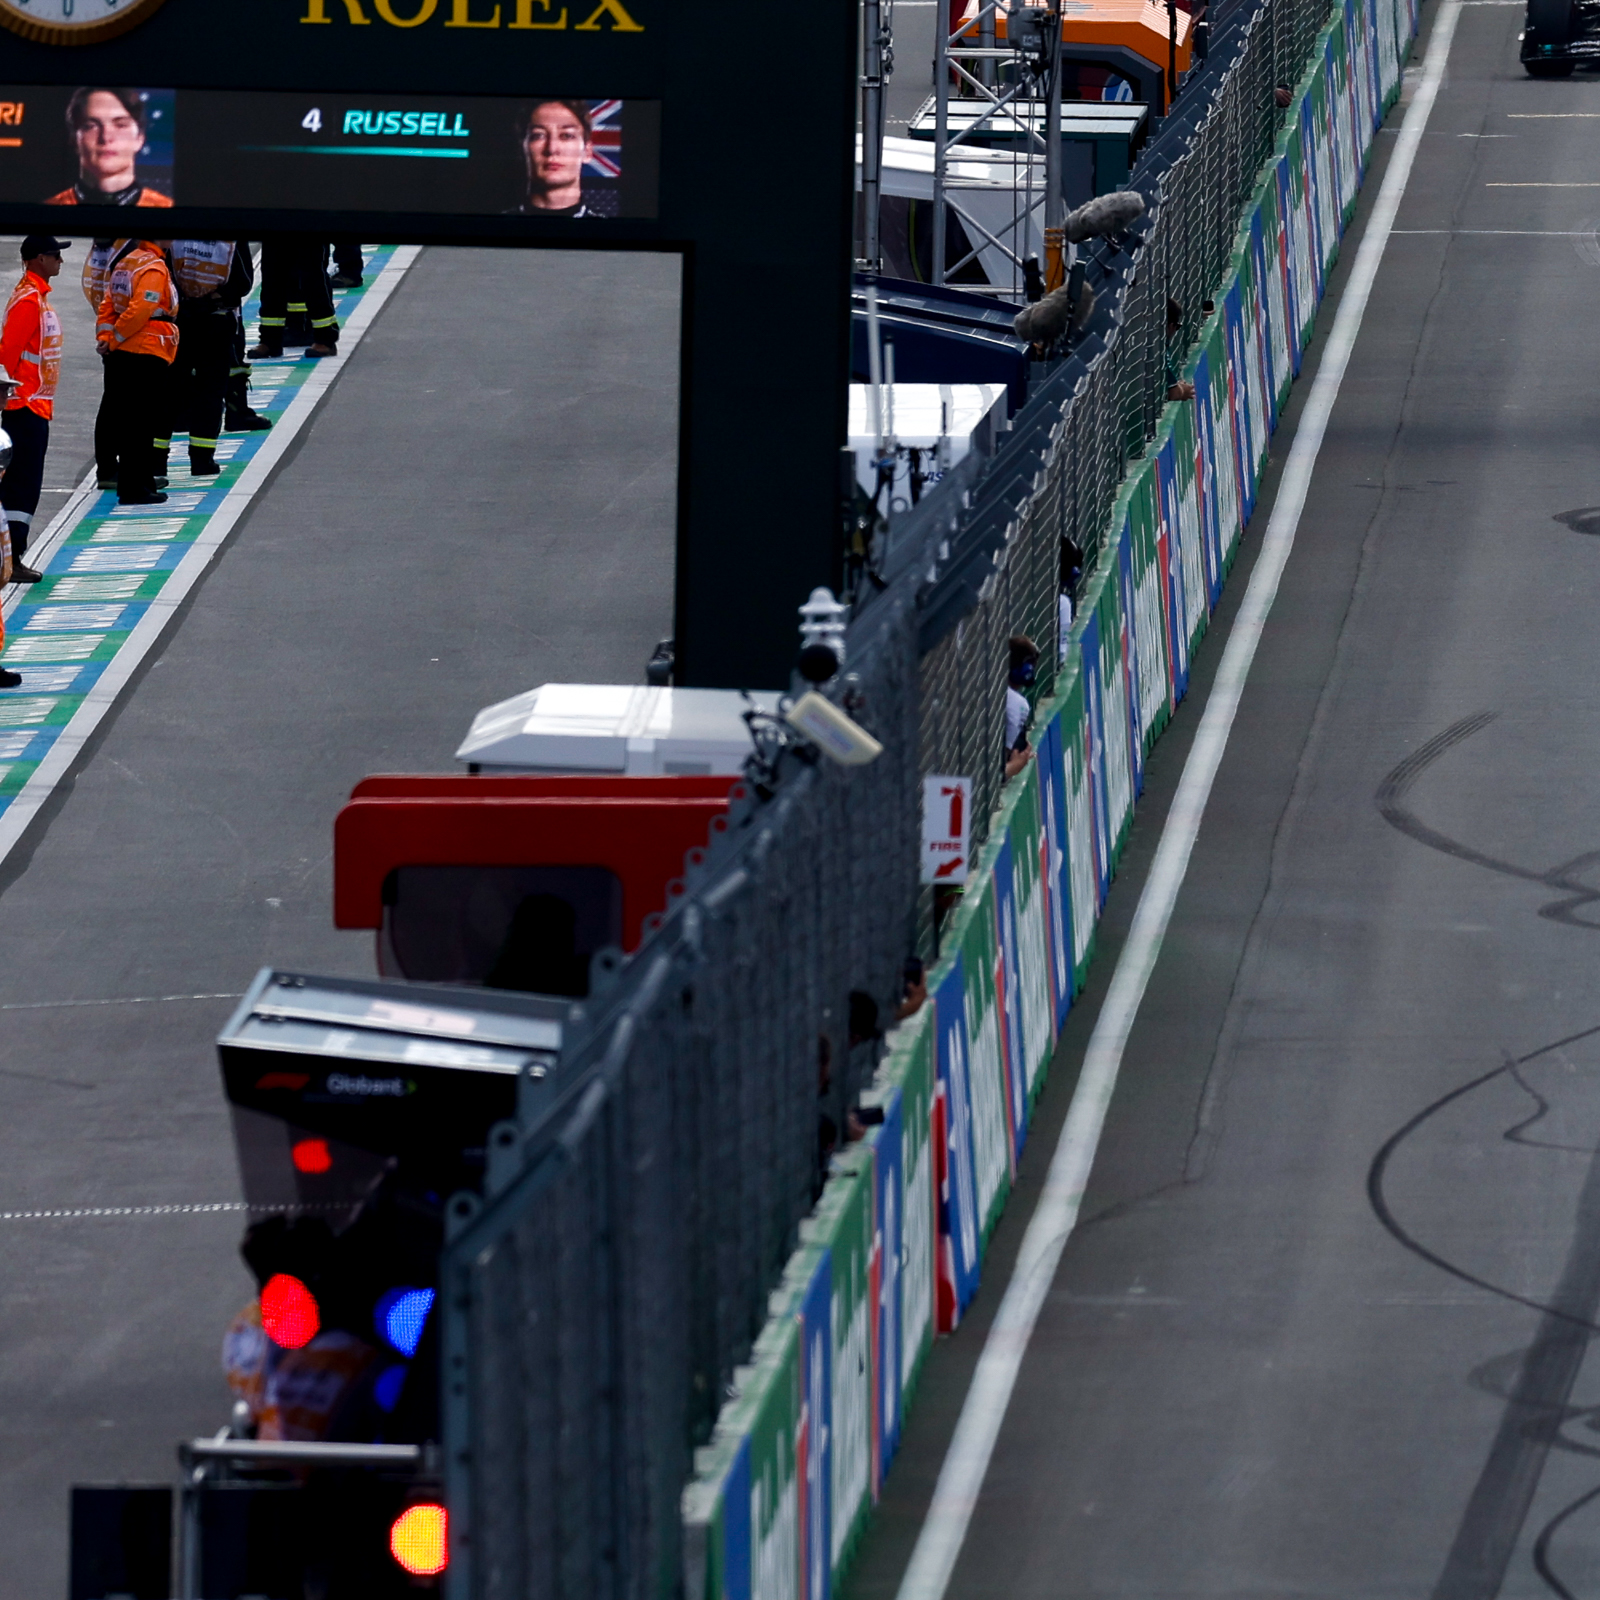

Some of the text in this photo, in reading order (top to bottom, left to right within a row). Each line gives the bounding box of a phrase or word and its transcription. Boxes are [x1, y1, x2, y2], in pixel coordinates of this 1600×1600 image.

[302, 108, 470, 137] 4 RUSSELL
[930, 842, 962, 852] FIRE
